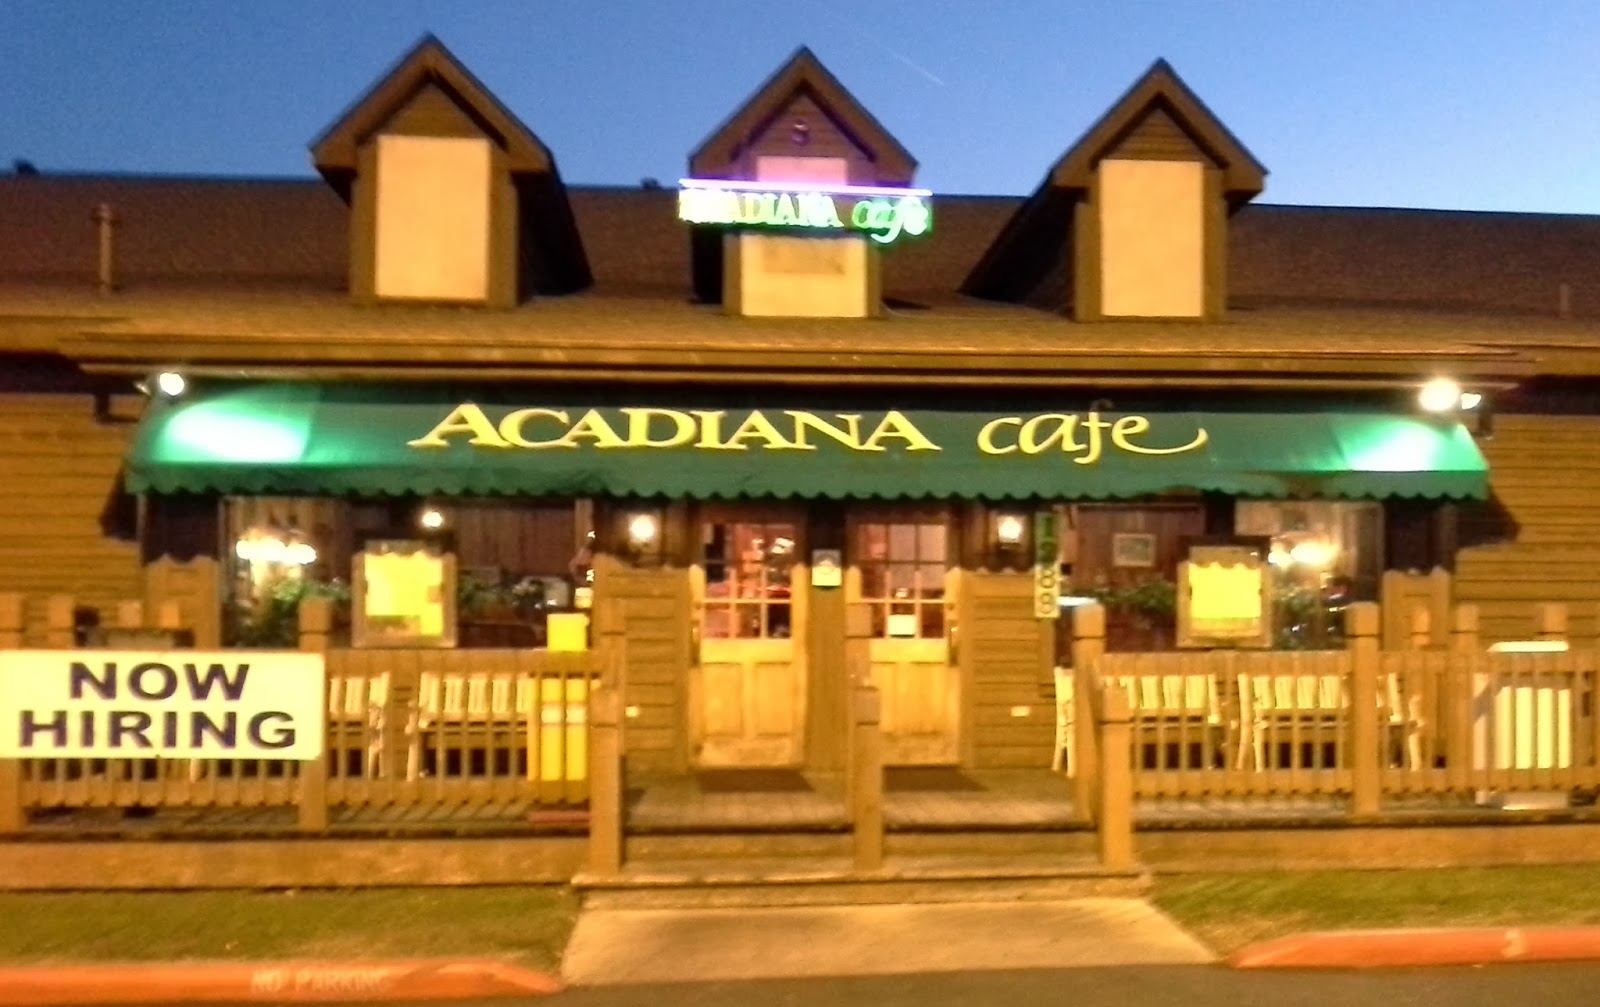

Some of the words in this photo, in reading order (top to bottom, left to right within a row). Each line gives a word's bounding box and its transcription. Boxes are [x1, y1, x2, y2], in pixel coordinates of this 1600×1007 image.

[679, 188, 844, 228] ADIANA
[406, 403, 943, 451] ACADIANA
[69, 662, 250, 701] NOW
[19, 710, 296, 750] HIRING
